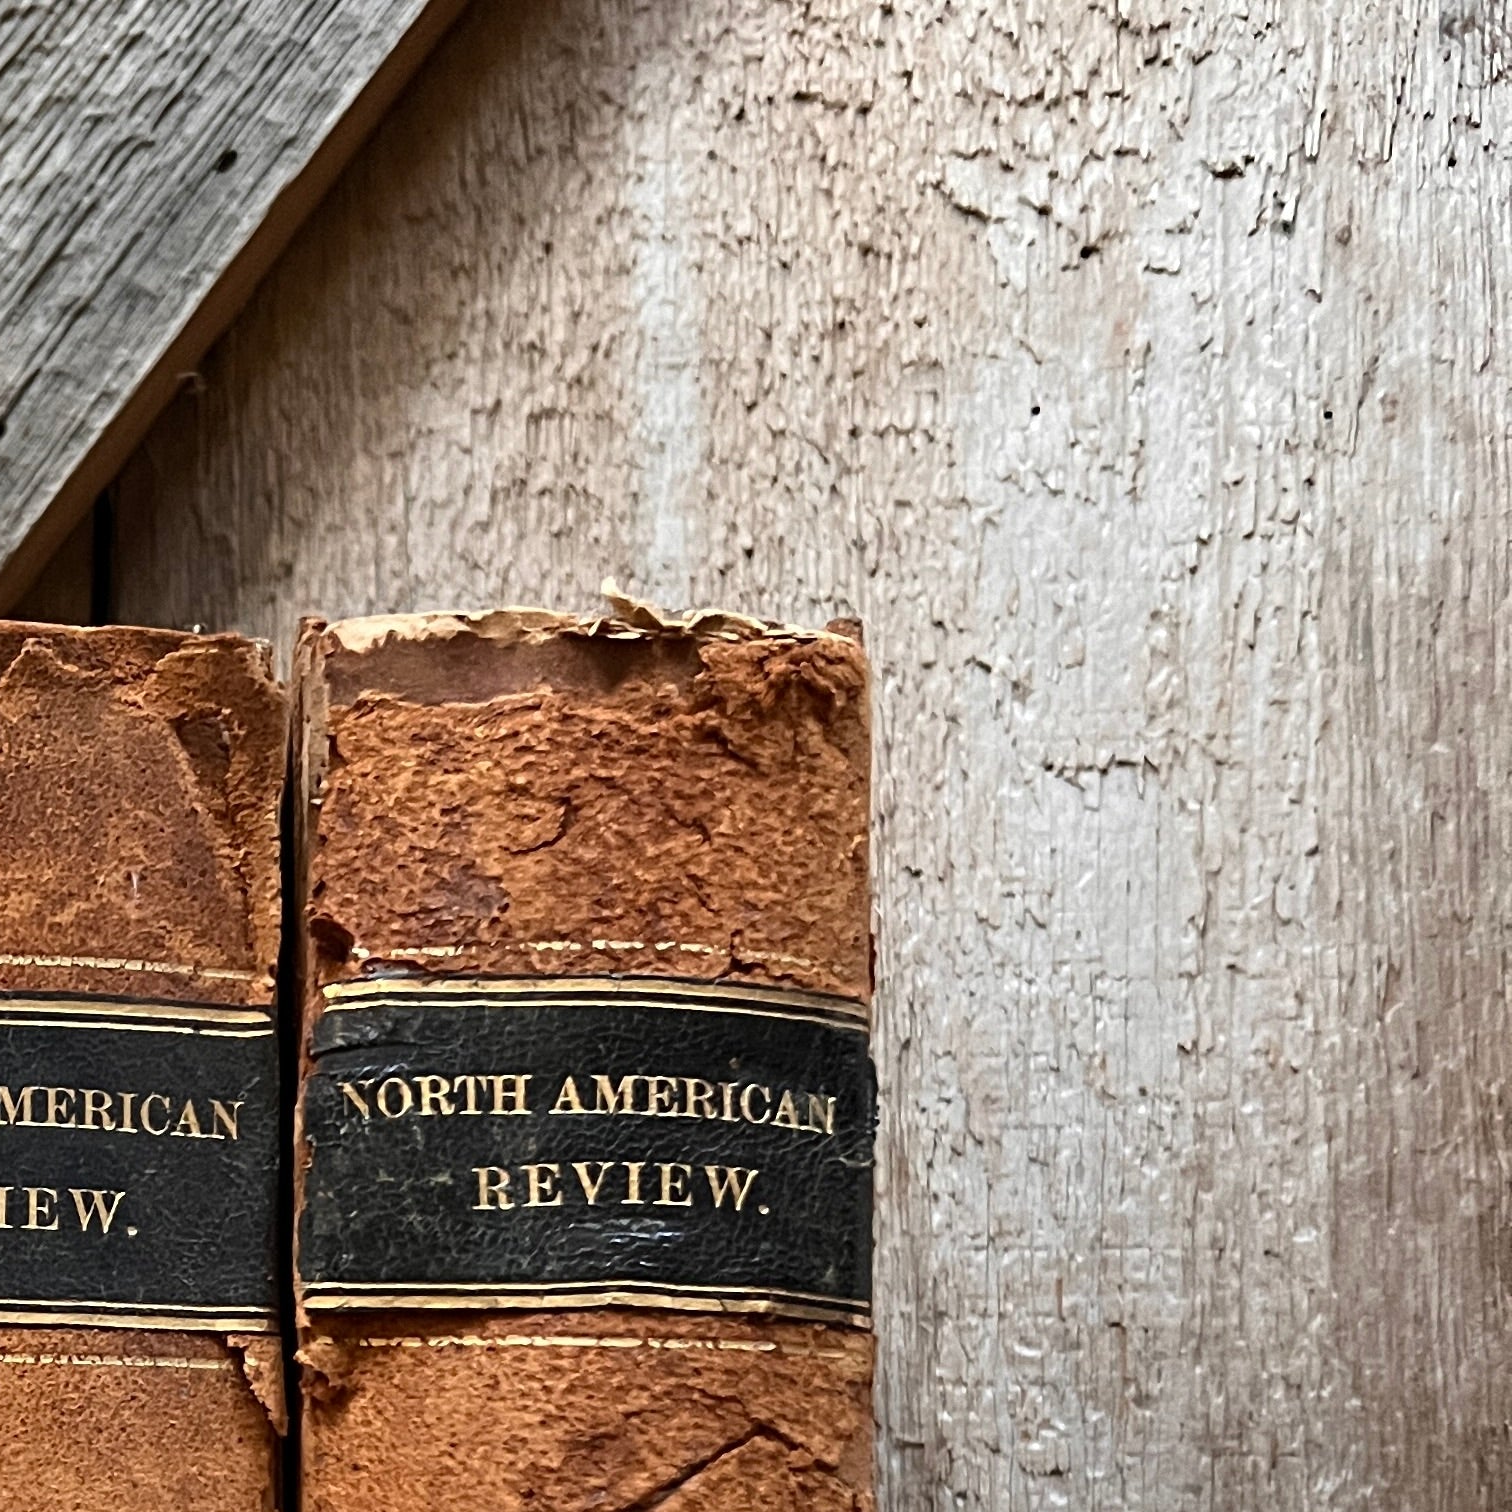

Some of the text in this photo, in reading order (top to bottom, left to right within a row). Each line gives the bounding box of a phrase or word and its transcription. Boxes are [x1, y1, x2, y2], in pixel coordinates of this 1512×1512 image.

[336, 1074, 837, 1135] NORTH AMERICAN
[471, 1161, 770, 1215] REVIEW.
